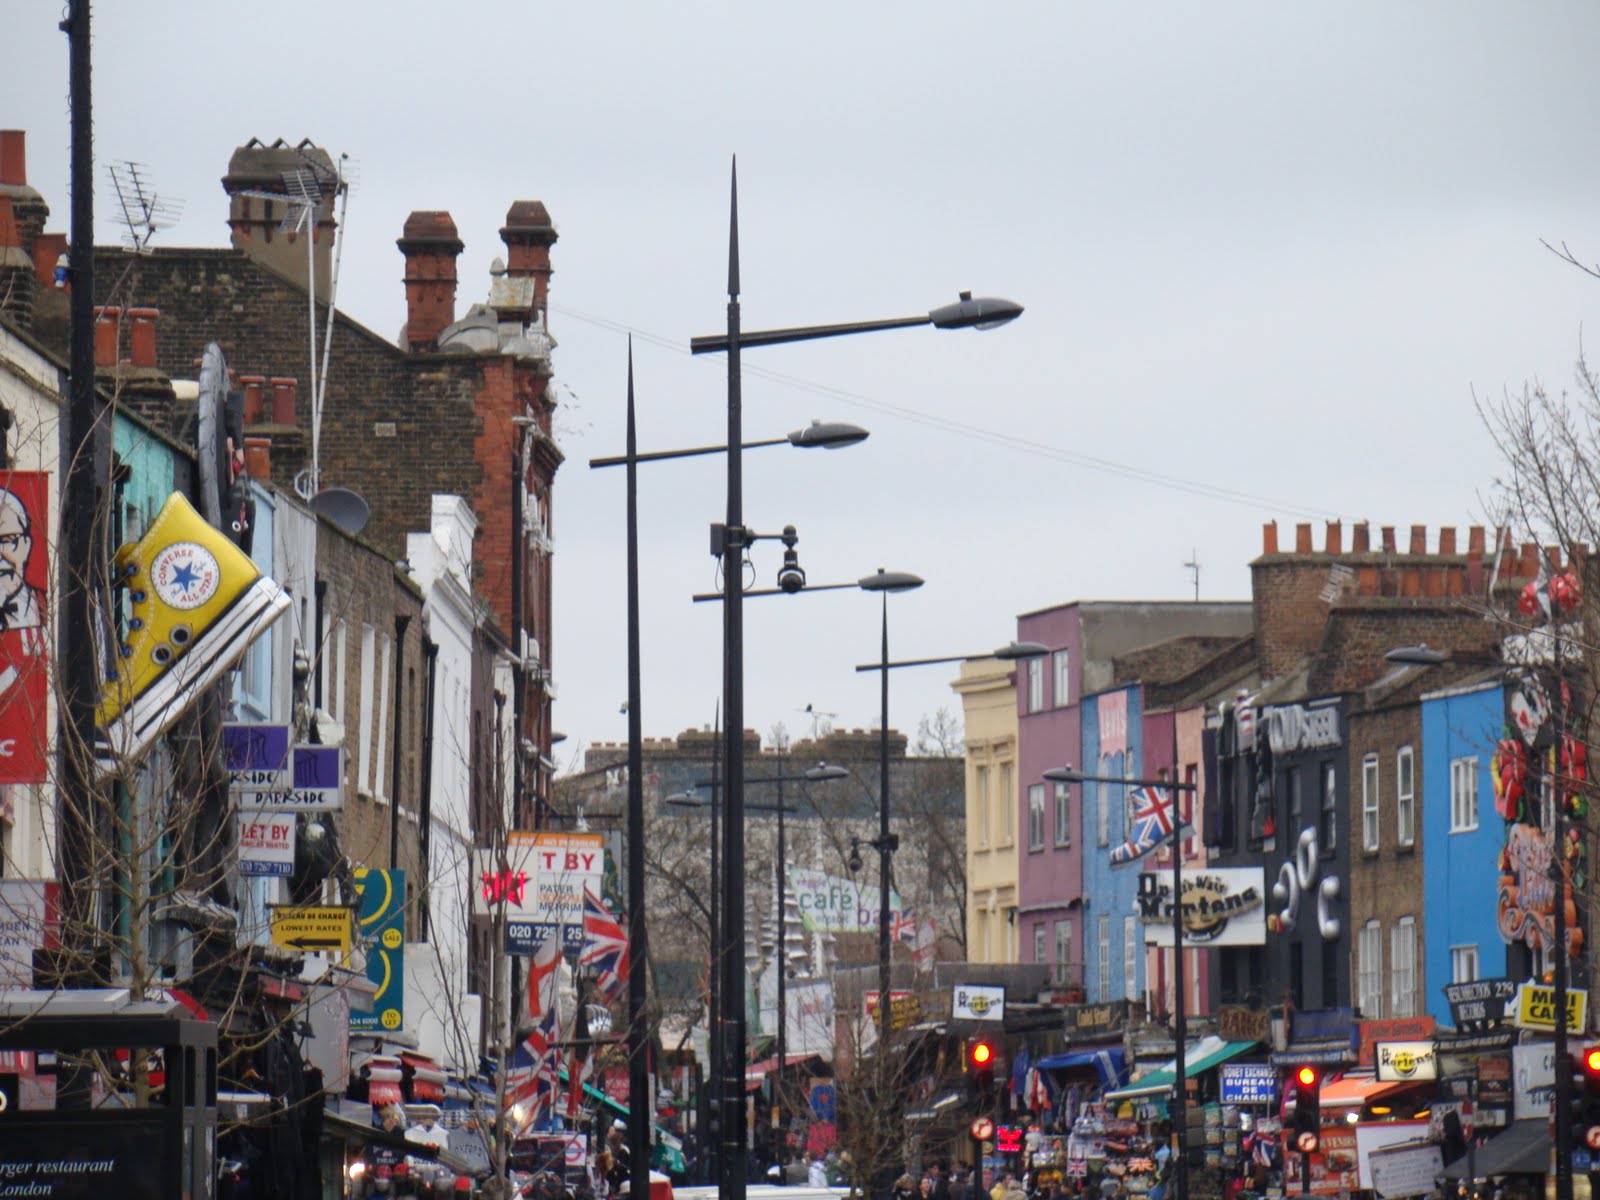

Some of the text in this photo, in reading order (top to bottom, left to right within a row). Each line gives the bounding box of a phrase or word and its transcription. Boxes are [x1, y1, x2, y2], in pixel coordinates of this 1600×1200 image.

[159, 549, 194, 586] CONVERSE
[180, 593, 199, 602] ALL
[199, 571, 212, 596] STAR
[242, 823, 290, 841] LET BY
[565, 853, 596, 871] BY
[800, 885, 853, 911] café
[1138, 886, 1258, 919] Martens
[316, 924, 342, 932] RATES
[509, 925, 531, 938] 020
[384, 934, 401, 942] SALE
[1226, 1078, 1274, 1086] BUREAU
[1242, 1086, 1258, 1094] DE
[1226, 1094, 1275, 1102] CHANGE
[36, 1159, 114, 1172] restaurant
